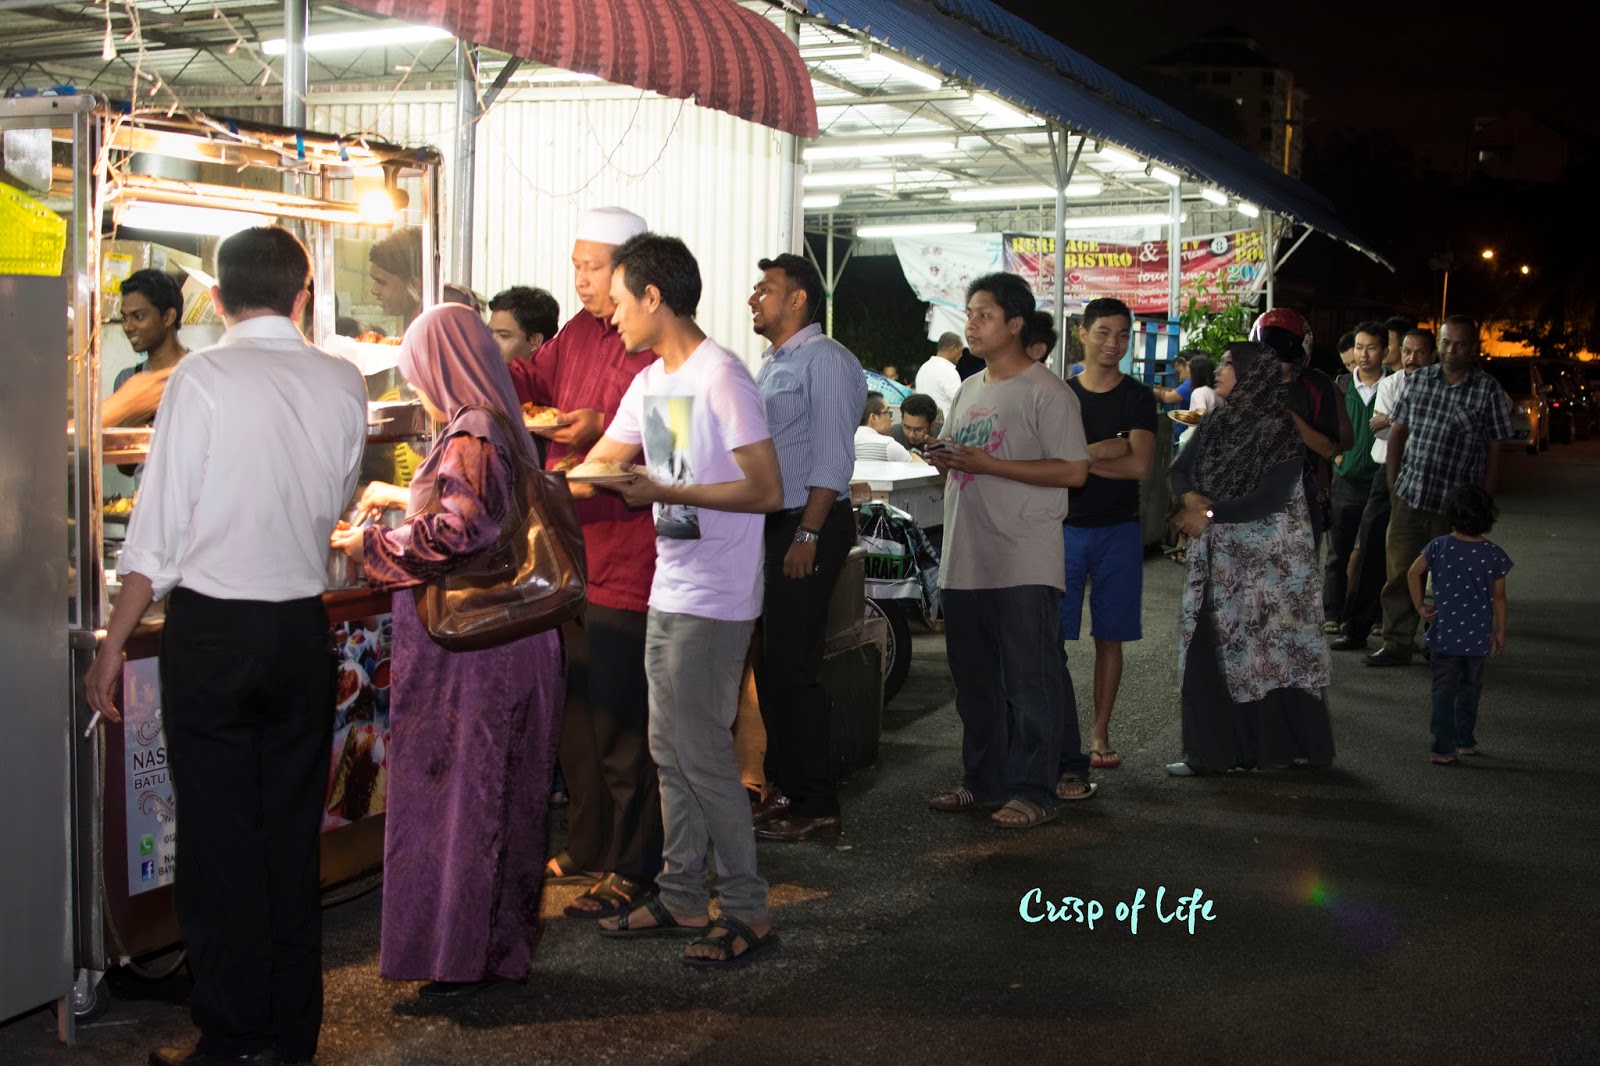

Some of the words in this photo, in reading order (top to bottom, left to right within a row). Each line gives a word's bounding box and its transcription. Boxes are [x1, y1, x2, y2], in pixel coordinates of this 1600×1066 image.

[1012, 238, 1100, 254] HERIAGE
[1139, 242, 1160, 262] &
[1064, 252, 1133, 269] BISTRO
[1181, 249, 1207, 261] Team
[1083, 274, 1120, 283] Community
[1138, 268, 1221, 283] tourament
[134, 773, 166, 790] BATU
